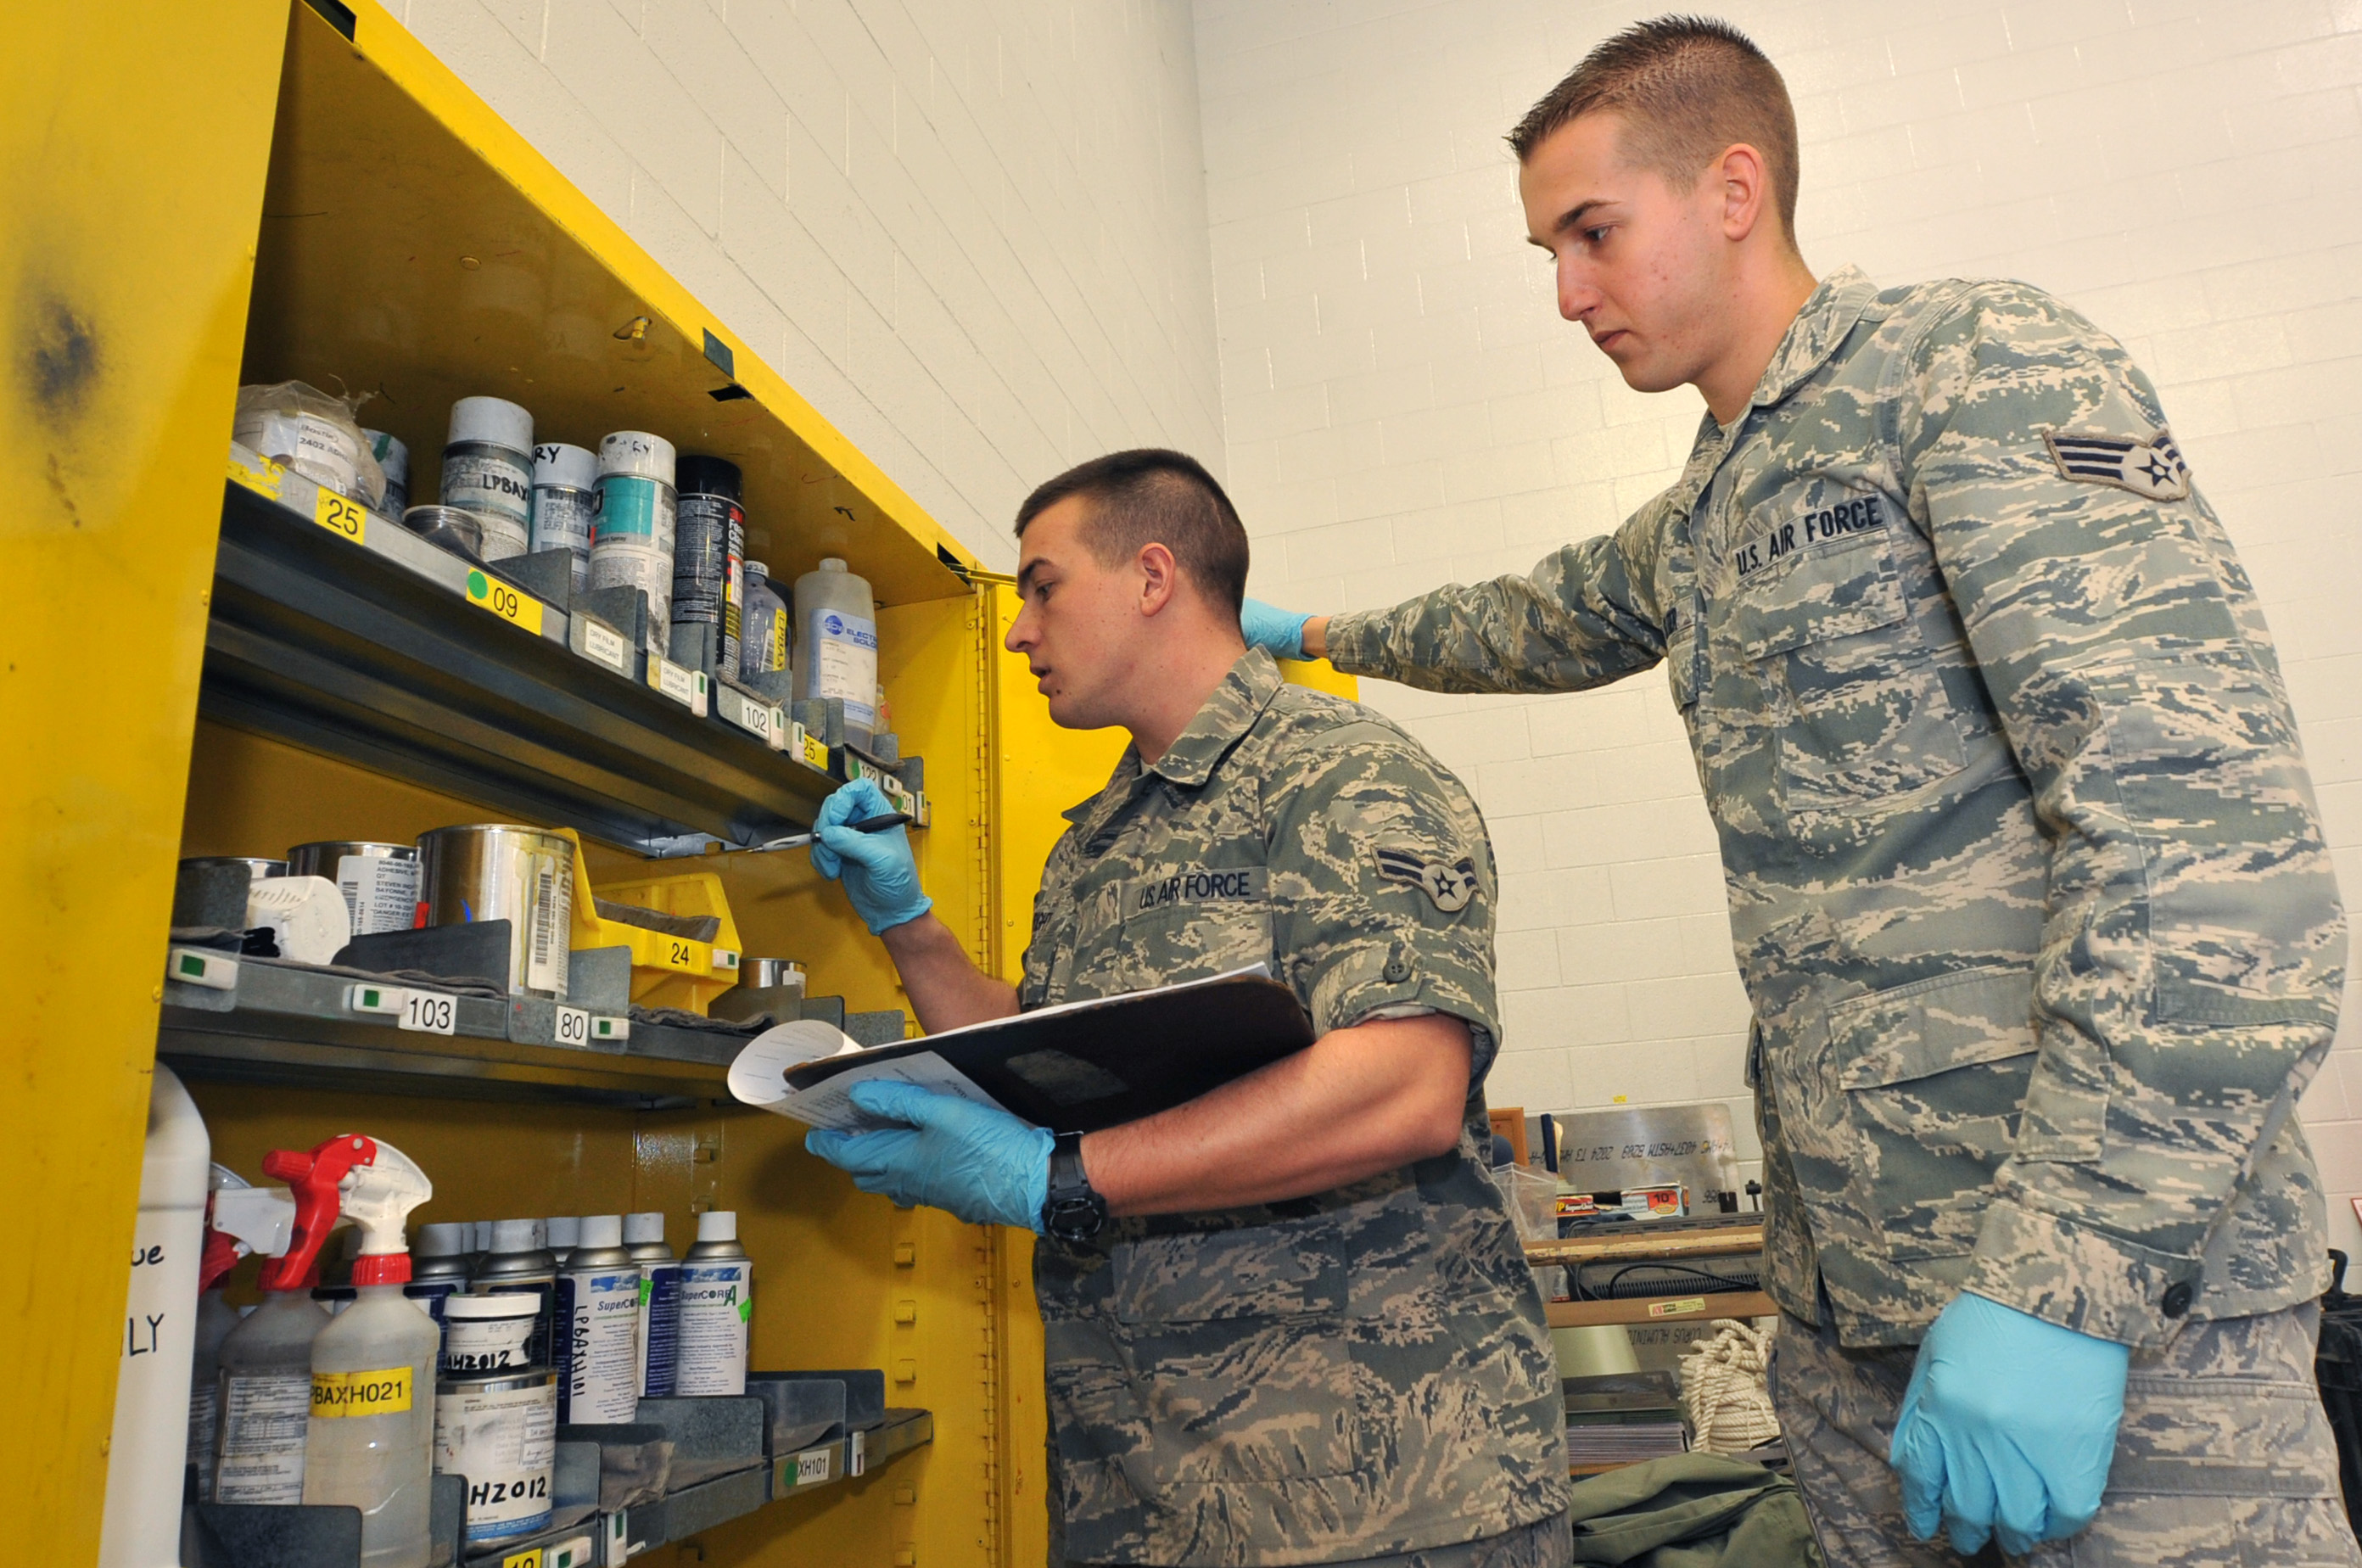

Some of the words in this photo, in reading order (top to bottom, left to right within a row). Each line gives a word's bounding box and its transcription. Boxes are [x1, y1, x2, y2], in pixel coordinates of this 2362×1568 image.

[299, 437, 326, 451] 2402
[327, 498, 358, 536] 25
[1736, 544, 1762, 576] U.S.
[1768, 523, 1795, 562] AIR
[1805, 496, 1883, 543] FORCE
[494, 586, 518, 618] 09
[745, 706, 768, 733] 102
[1156, 877, 1181, 904] AIR
[1184, 871, 1251, 899] FORCE
[671, 943, 690, 966] 24
[409, 997, 451, 1030] 103
[560, 1014, 584, 1040] 80
[129, 1314, 165, 1357] LY
[570, 1305, 590, 1397] LPBAXH101
[469, 1476, 546, 1506] HZ012
